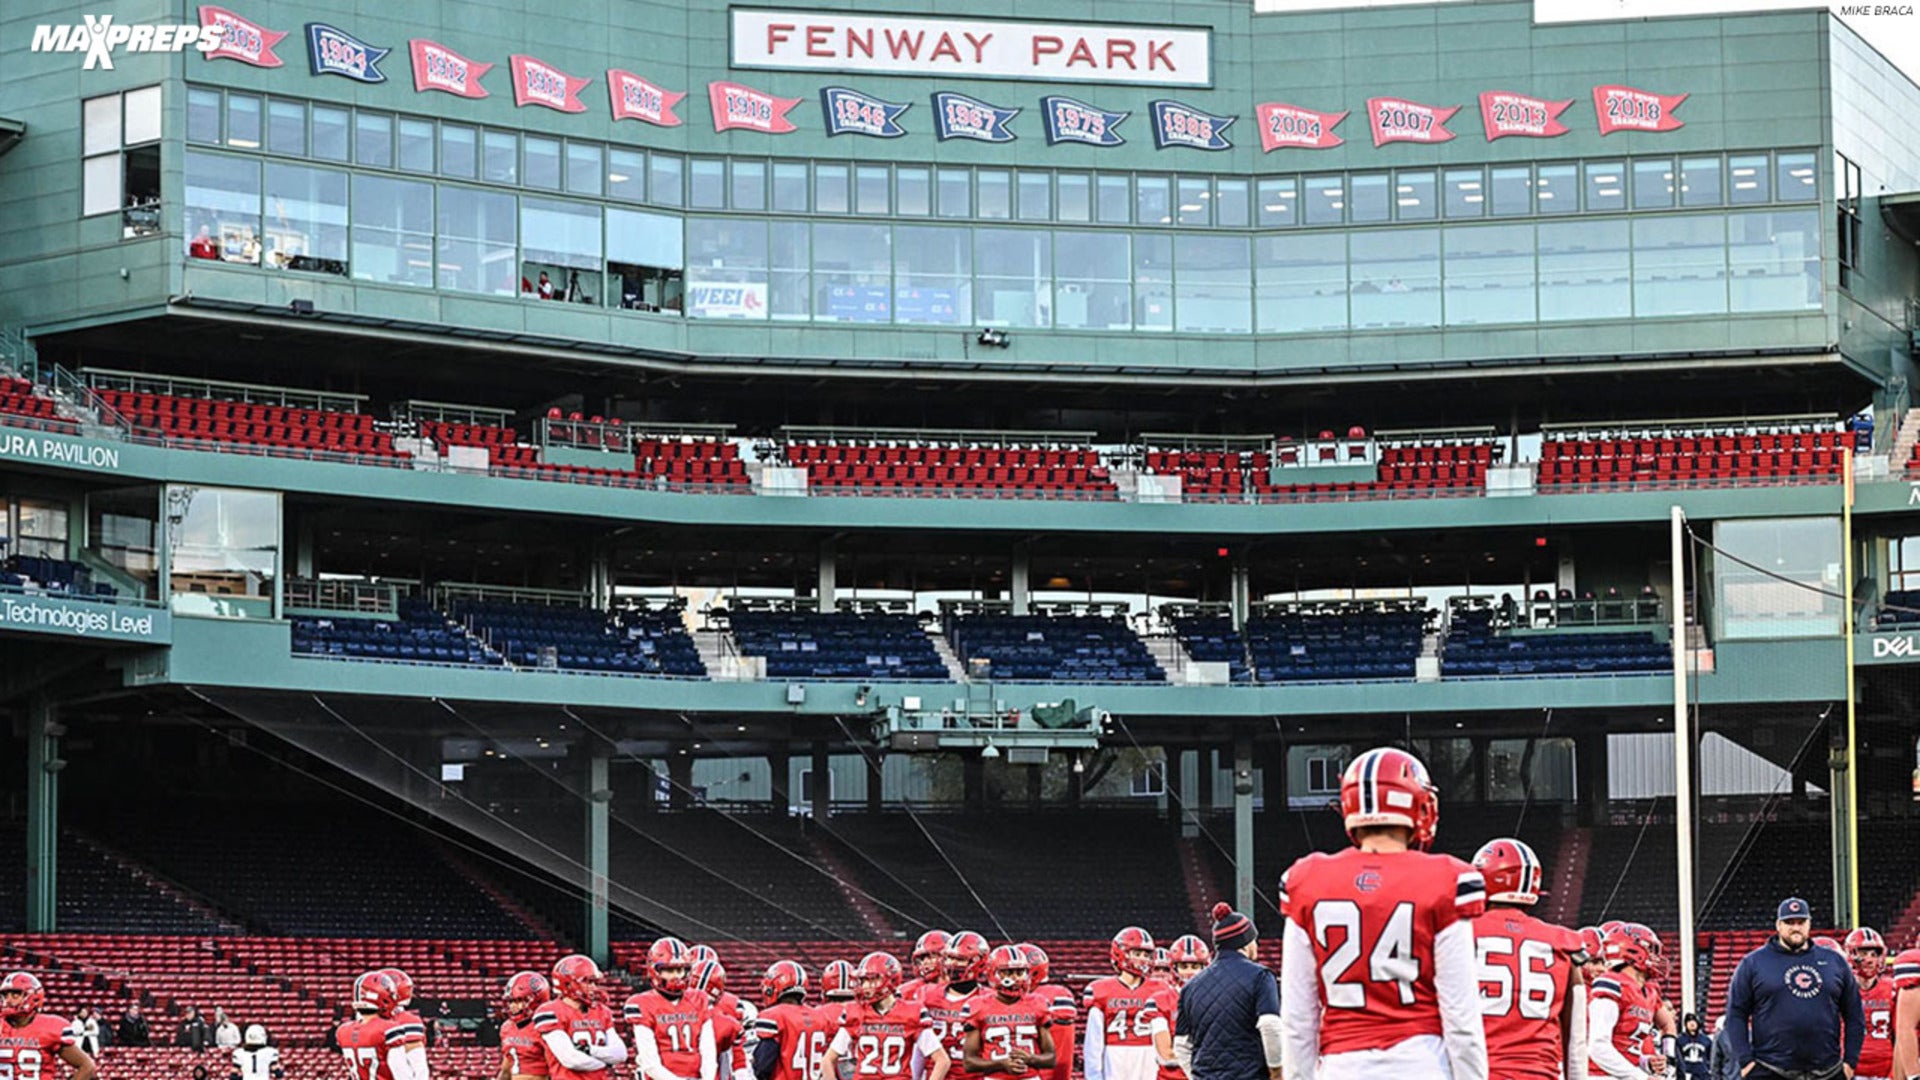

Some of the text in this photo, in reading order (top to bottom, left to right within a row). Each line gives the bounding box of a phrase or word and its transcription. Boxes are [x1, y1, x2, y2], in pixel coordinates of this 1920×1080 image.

[214, 20, 262, 54] 903
[766, 23, 1177, 72] FENWAY PARK
[319, 37, 367, 71] 1904
[426, 52, 468, 85] 1912
[622, 85, 662, 114] 1916
[726, 95, 772, 121] 1918
[836, 99, 885, 127] 1946
[1606, 96, 1661, 121] 2018
[946, 104, 996, 131] 1967
[1056, 107, 1105, 136] 1975
[1163, 112, 1213, 140] 1986
[1270, 114, 1321, 138] 2004
[1379, 108, 1434, 132] 2007
[1493, 102, 1547, 127] 2013
[42, 441, 119, 469] PAVILION
[3, 600, 153, 635] Technologies Level
[1311, 899, 1421, 1009] 24
[1475, 935, 1557, 1020] 56
[666, 1024, 697, 1052] 11
[984, 1025, 1038, 1061] 35
[792, 1030, 826, 1080] 46
[858, 1035, 906, 1075] 20
